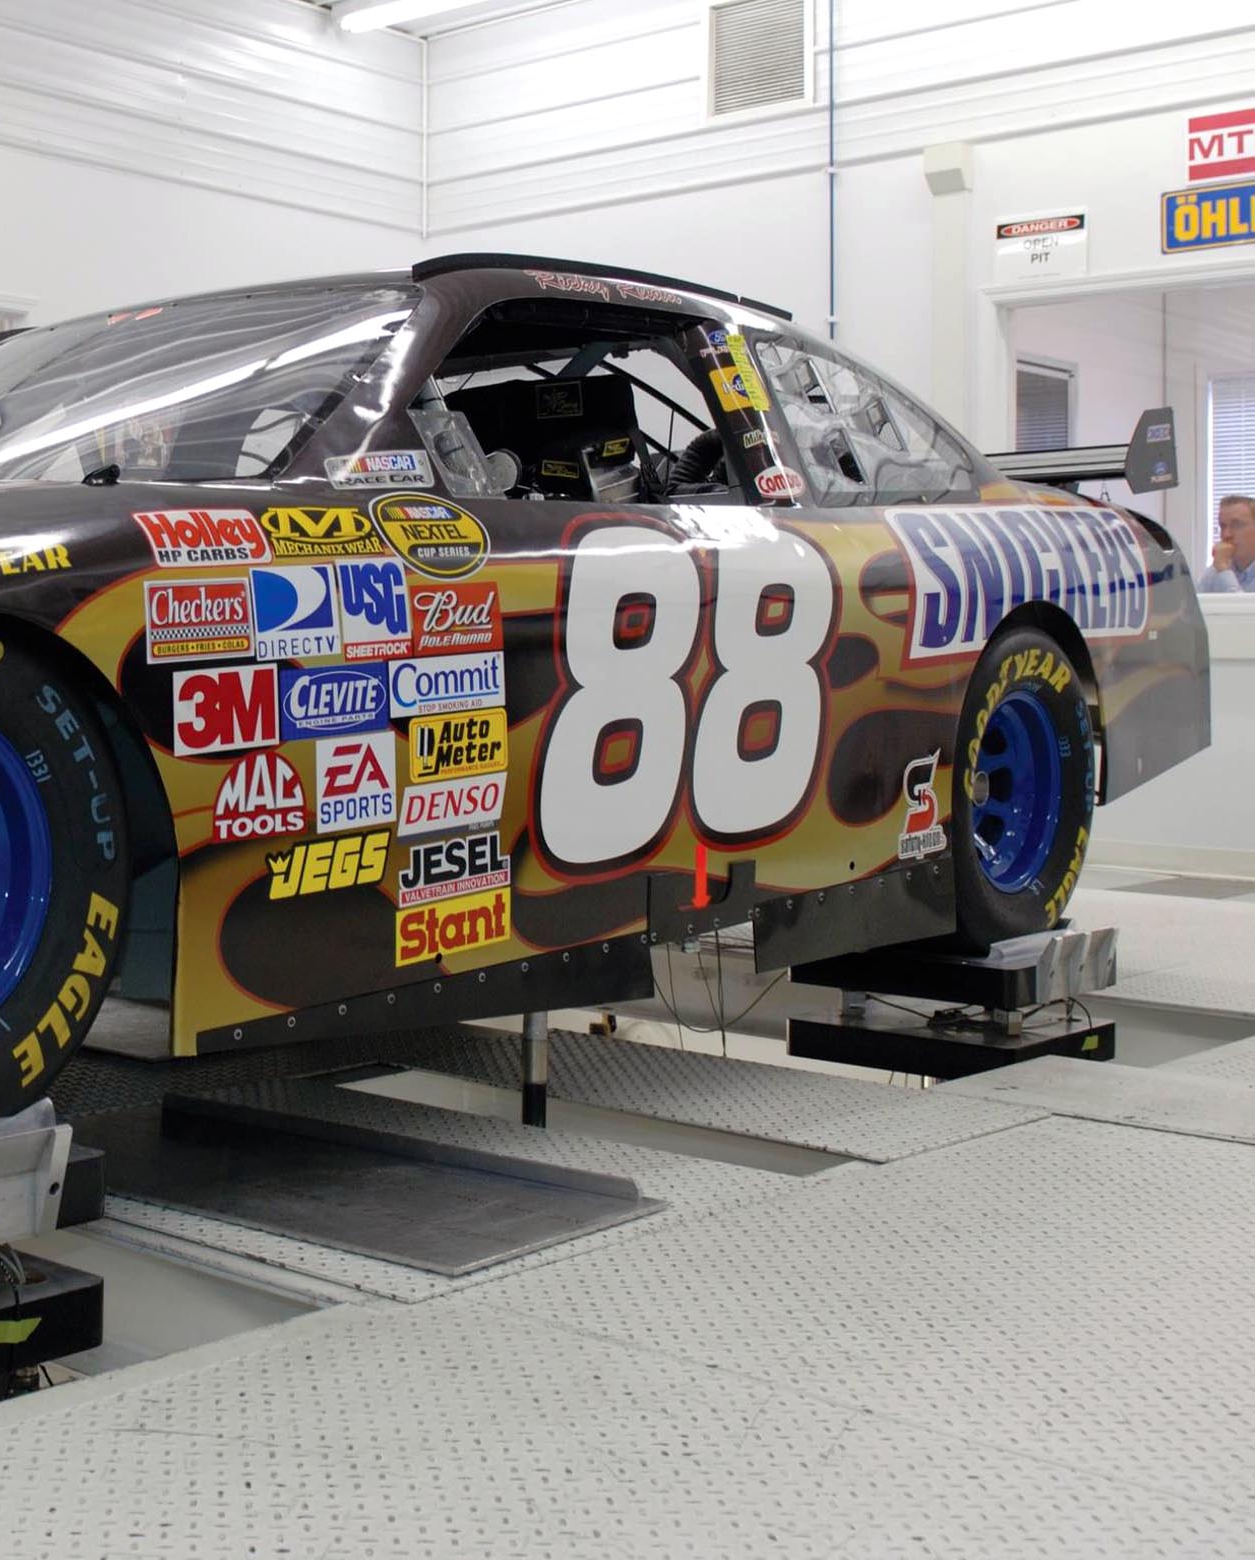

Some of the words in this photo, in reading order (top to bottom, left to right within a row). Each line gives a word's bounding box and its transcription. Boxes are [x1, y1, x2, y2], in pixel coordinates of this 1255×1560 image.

[1011, 219, 1069, 235] DANGER
[1023, 236, 1059, 250] OPEN
[1030, 252, 1050, 264] PIT
[367, 455, 415, 472] NASCAR
[339, 475, 385, 486] RACE
[389, 474, 425, 483] CAR
[408, 505, 453, 519] NASCAR
[138, 511, 266, 559] Holley
[274, 537, 345, 556] MECHANIX
[347, 538, 384, 555] WEAR
[403, 525, 468, 540] NEXTEL
[158, 550, 182, 563] HP
[187, 547, 249, 562] CARBS
[417, 546, 437, 558] CUP
[439, 546, 471, 558] SERIES
[895, 510, 1145, 649] SNICKERS
[151, 587, 244, 625] Checkers
[339, 562, 408, 635] USG
[414, 590, 495, 633] Bud
[156, 642, 189, 653] BURGERS
[196, 641, 217, 651] FRIES
[222, 639, 245, 649] COLAS
[258, 635, 336, 659] DIRECTV
[346, 642, 408, 659] SHEETROCK
[290, 675, 379, 718] CLEVITE
[394, 659, 501, 709] Commit
[538, 518, 834, 865] 88
[178, 668, 277, 749] 3M
[418, 703, 437, 713] STOP
[438, 700, 470, 711] SMOKING
[471, 699, 483, 708] AID
[438, 717, 491, 744] Auto
[322, 743, 390, 798] EA
[435, 740, 502, 771] Meter
[216, 753, 305, 815] MAC
[321, 793, 393, 825] SPORTS
[405, 782, 500, 825] DENSO
[215, 810, 305, 839] TOOLS
[269, 831, 391, 900] JEGS
[400, 833, 505, 889] JESEL
[404, 883, 455, 903] VALVETRAIN
[456, 872, 506, 895] INNOVATION
[399, 893, 507, 961] Stant
[12, 892, 119, 1088] EAGLE
